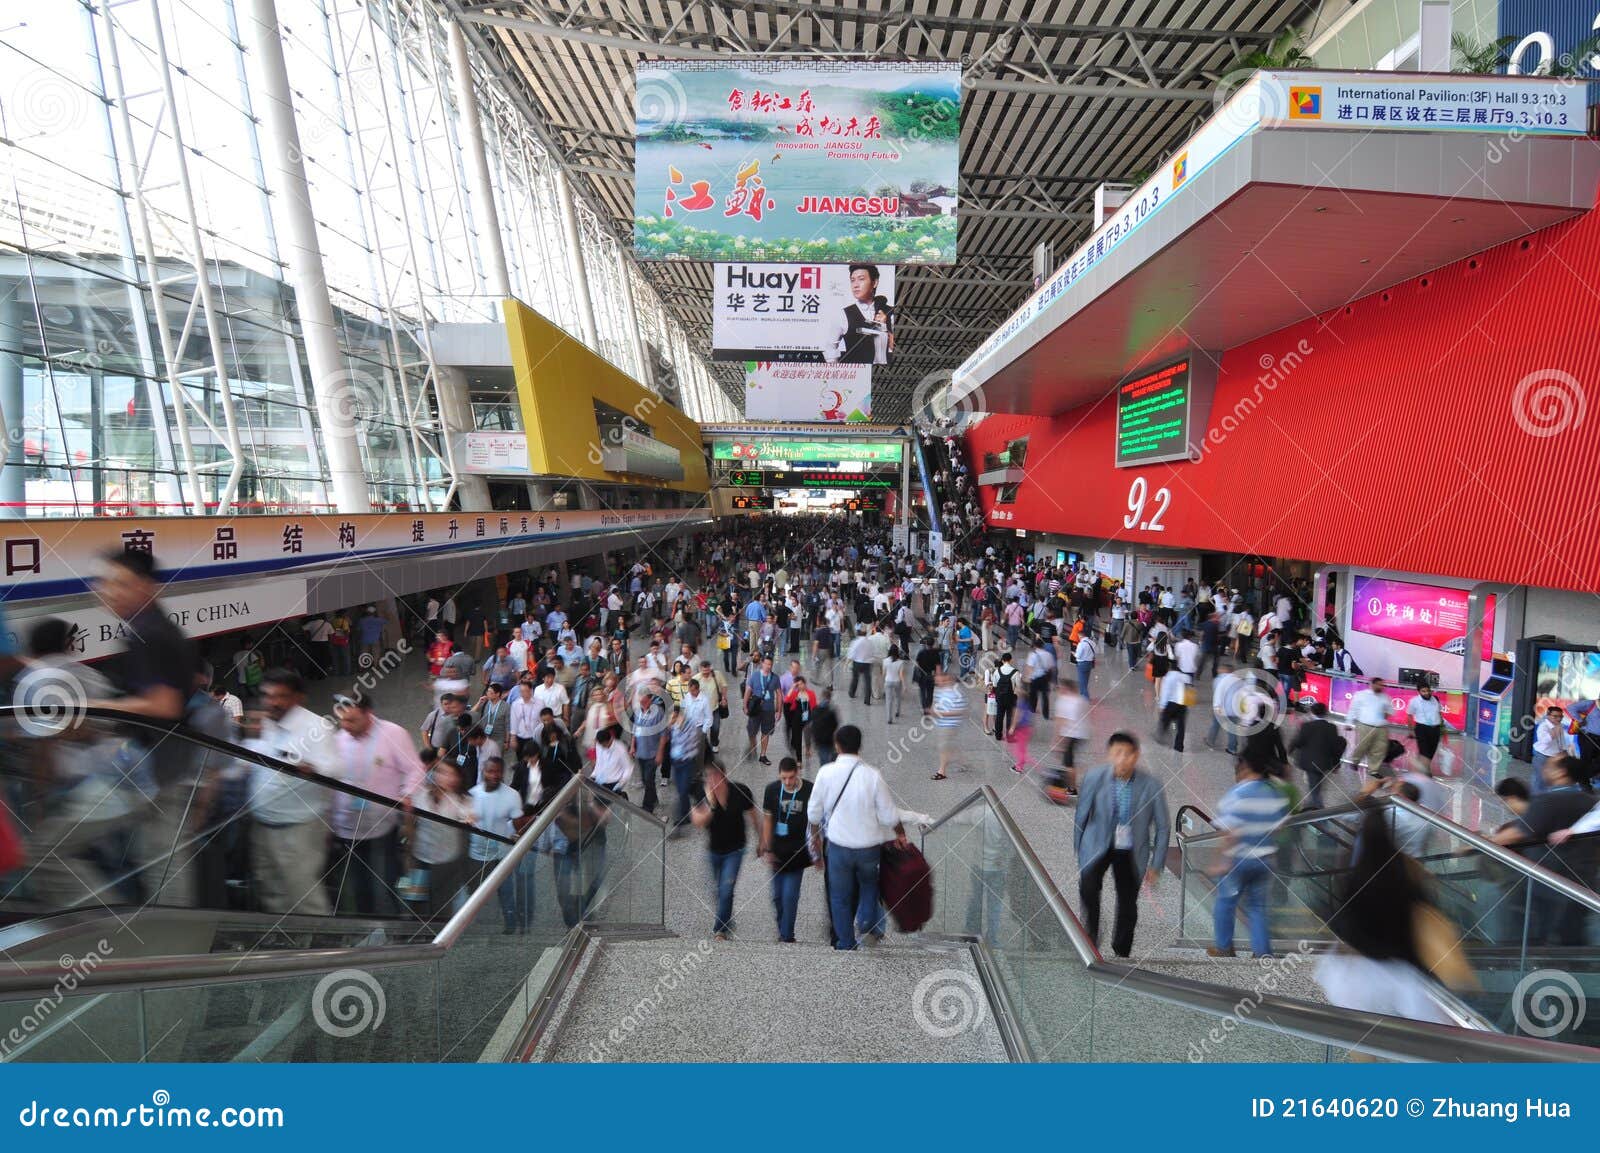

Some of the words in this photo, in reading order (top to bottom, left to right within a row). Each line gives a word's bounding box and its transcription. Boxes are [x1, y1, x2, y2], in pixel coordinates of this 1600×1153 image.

[1337, 87, 1415, 102] International
[1496, 91, 1519, 104] Hall
[775, 141, 819, 150] Innovation
[823, 141, 863, 150] JIANGSU
[827, 151, 870, 161] Promising
[871, 151, 900, 160] Future
[797, 196, 899, 215] JIANGSU
[726, 292, 821, 314] 华艺卫浴
[1123, 476, 1171, 532] 9.2
[196, 601, 251, 624] CHINA
[1385, 602, 1432, 624] 咨询处
